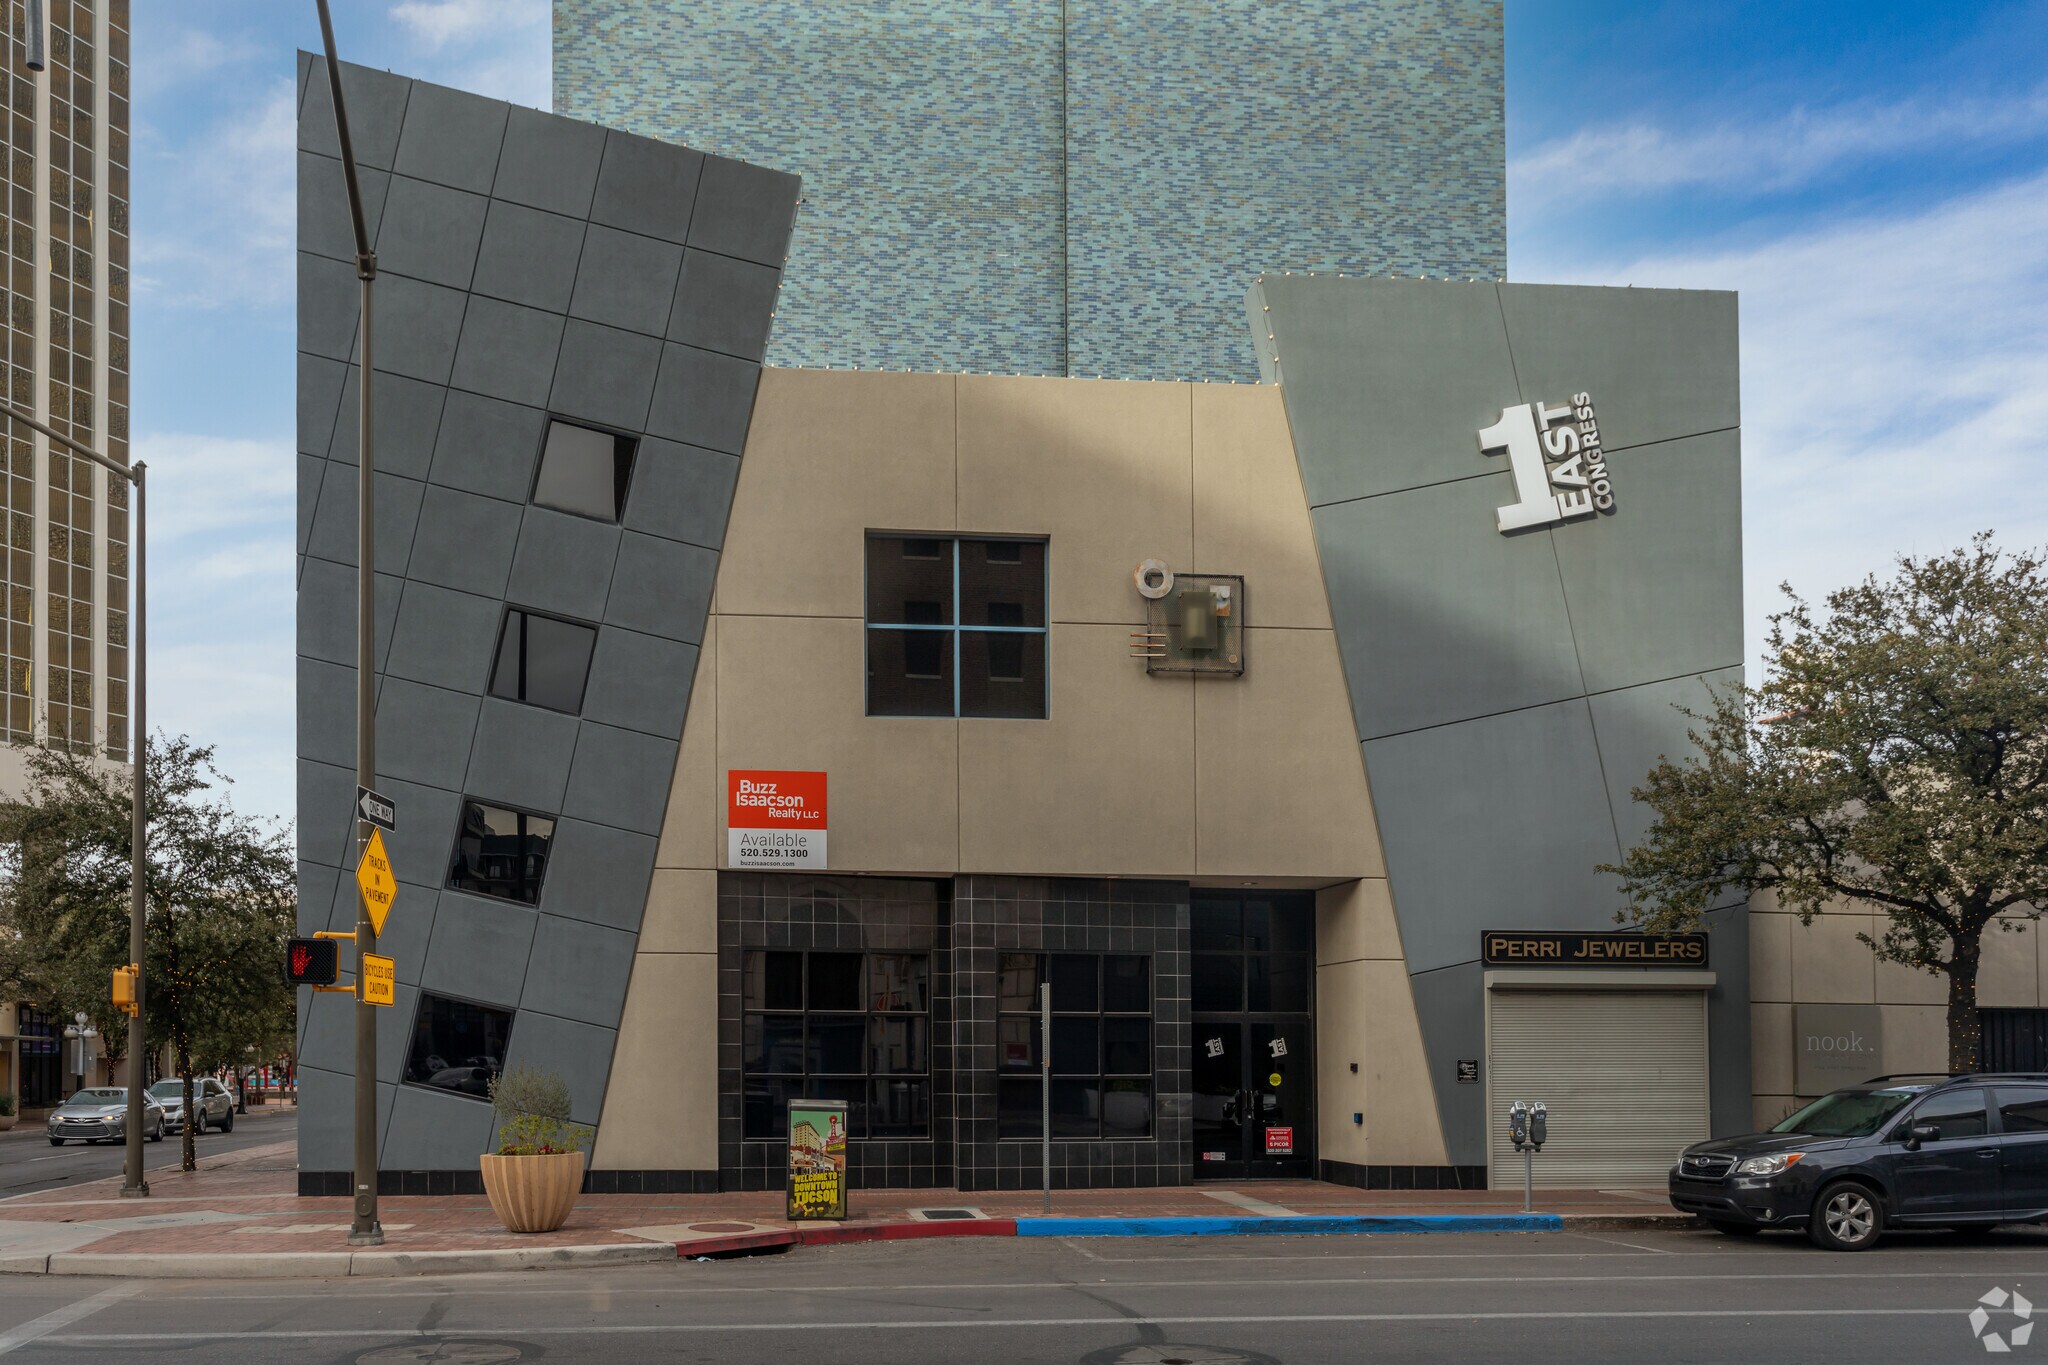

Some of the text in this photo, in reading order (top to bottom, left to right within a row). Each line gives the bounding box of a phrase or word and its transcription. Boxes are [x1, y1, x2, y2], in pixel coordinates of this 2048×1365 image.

[1573, 391, 1613, 510] CONGRESS
[1478, 403, 1561, 532] 1
[1536, 401, 1594, 518] EAST
[740, 779, 777, 794] Buzz
[736, 791, 804, 807] Isaacson
[369, 800, 393, 820] ONE WAY
[768, 807, 819, 820] Realty LLC
[740, 833, 807, 847] Available
[740, 848, 808, 858] 520.529.1300
[368, 854, 386, 872] TRACKS
[375, 873, 381, 886] IN
[365, 886, 389, 906] PAVEMENT
[1491, 938, 1702, 958] PERRI JEWELERS
[365, 963, 393, 980] BICYCLES USE
[369, 982, 389, 996] CAUTION
[795, 1171, 838, 1183] WELCOME TO
[794, 1180, 838, 1193] DOWNTOWN
[794, 1188, 838, 1205] TUCSON
